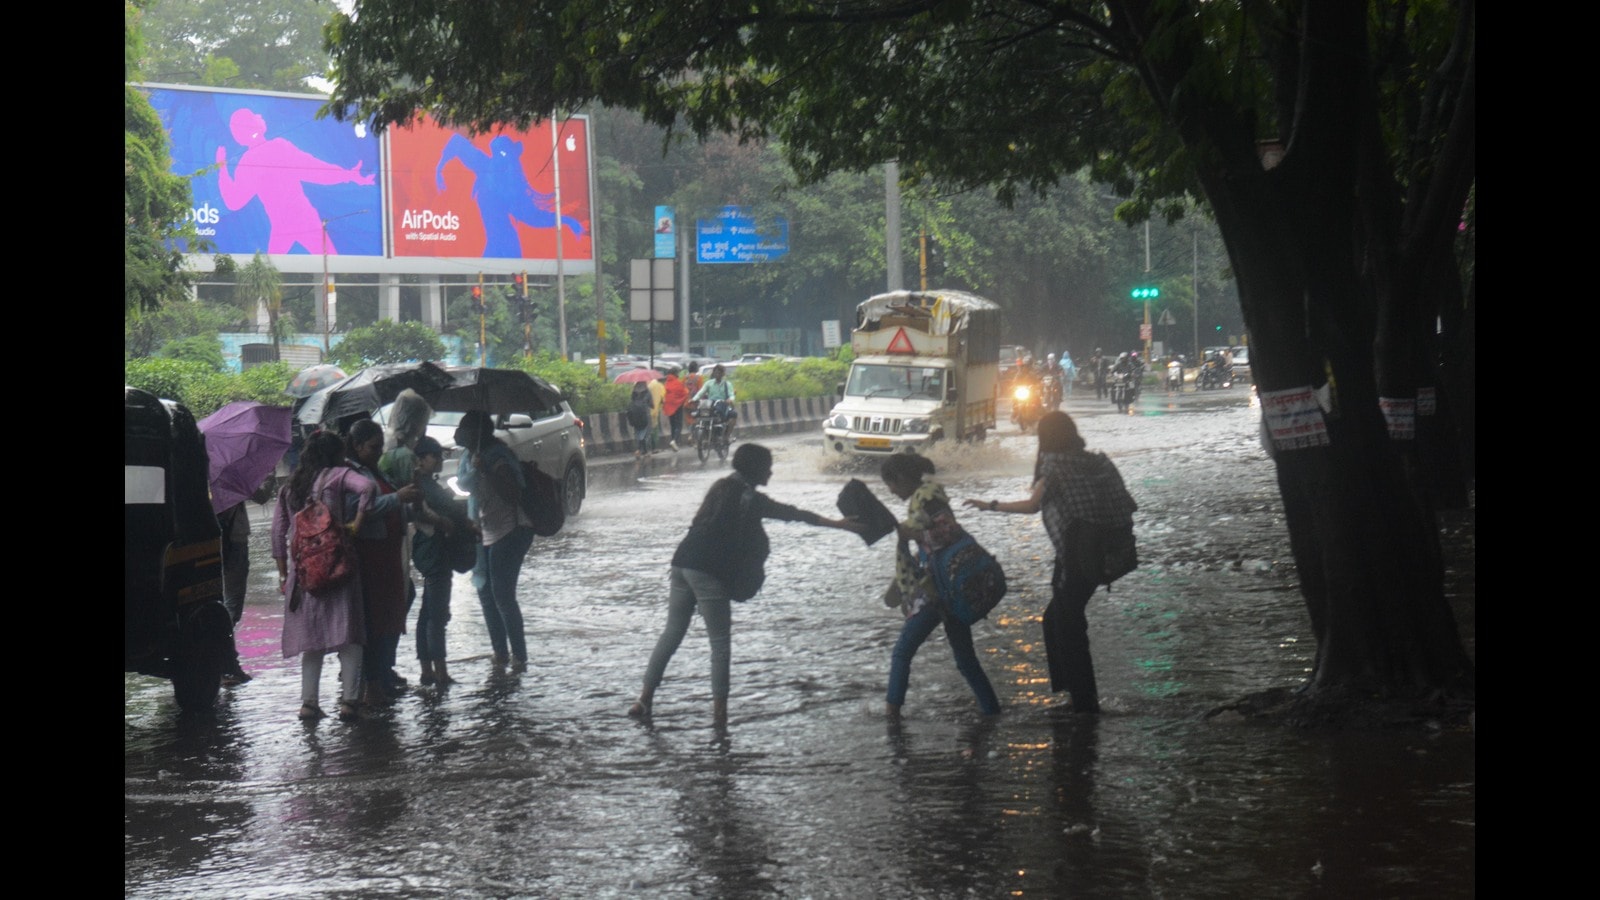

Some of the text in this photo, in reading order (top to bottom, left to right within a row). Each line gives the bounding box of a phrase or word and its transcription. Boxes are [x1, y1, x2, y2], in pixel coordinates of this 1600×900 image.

[401, 209, 460, 230] AirPods
[405, 232, 457, 242] with Spatial Audio
